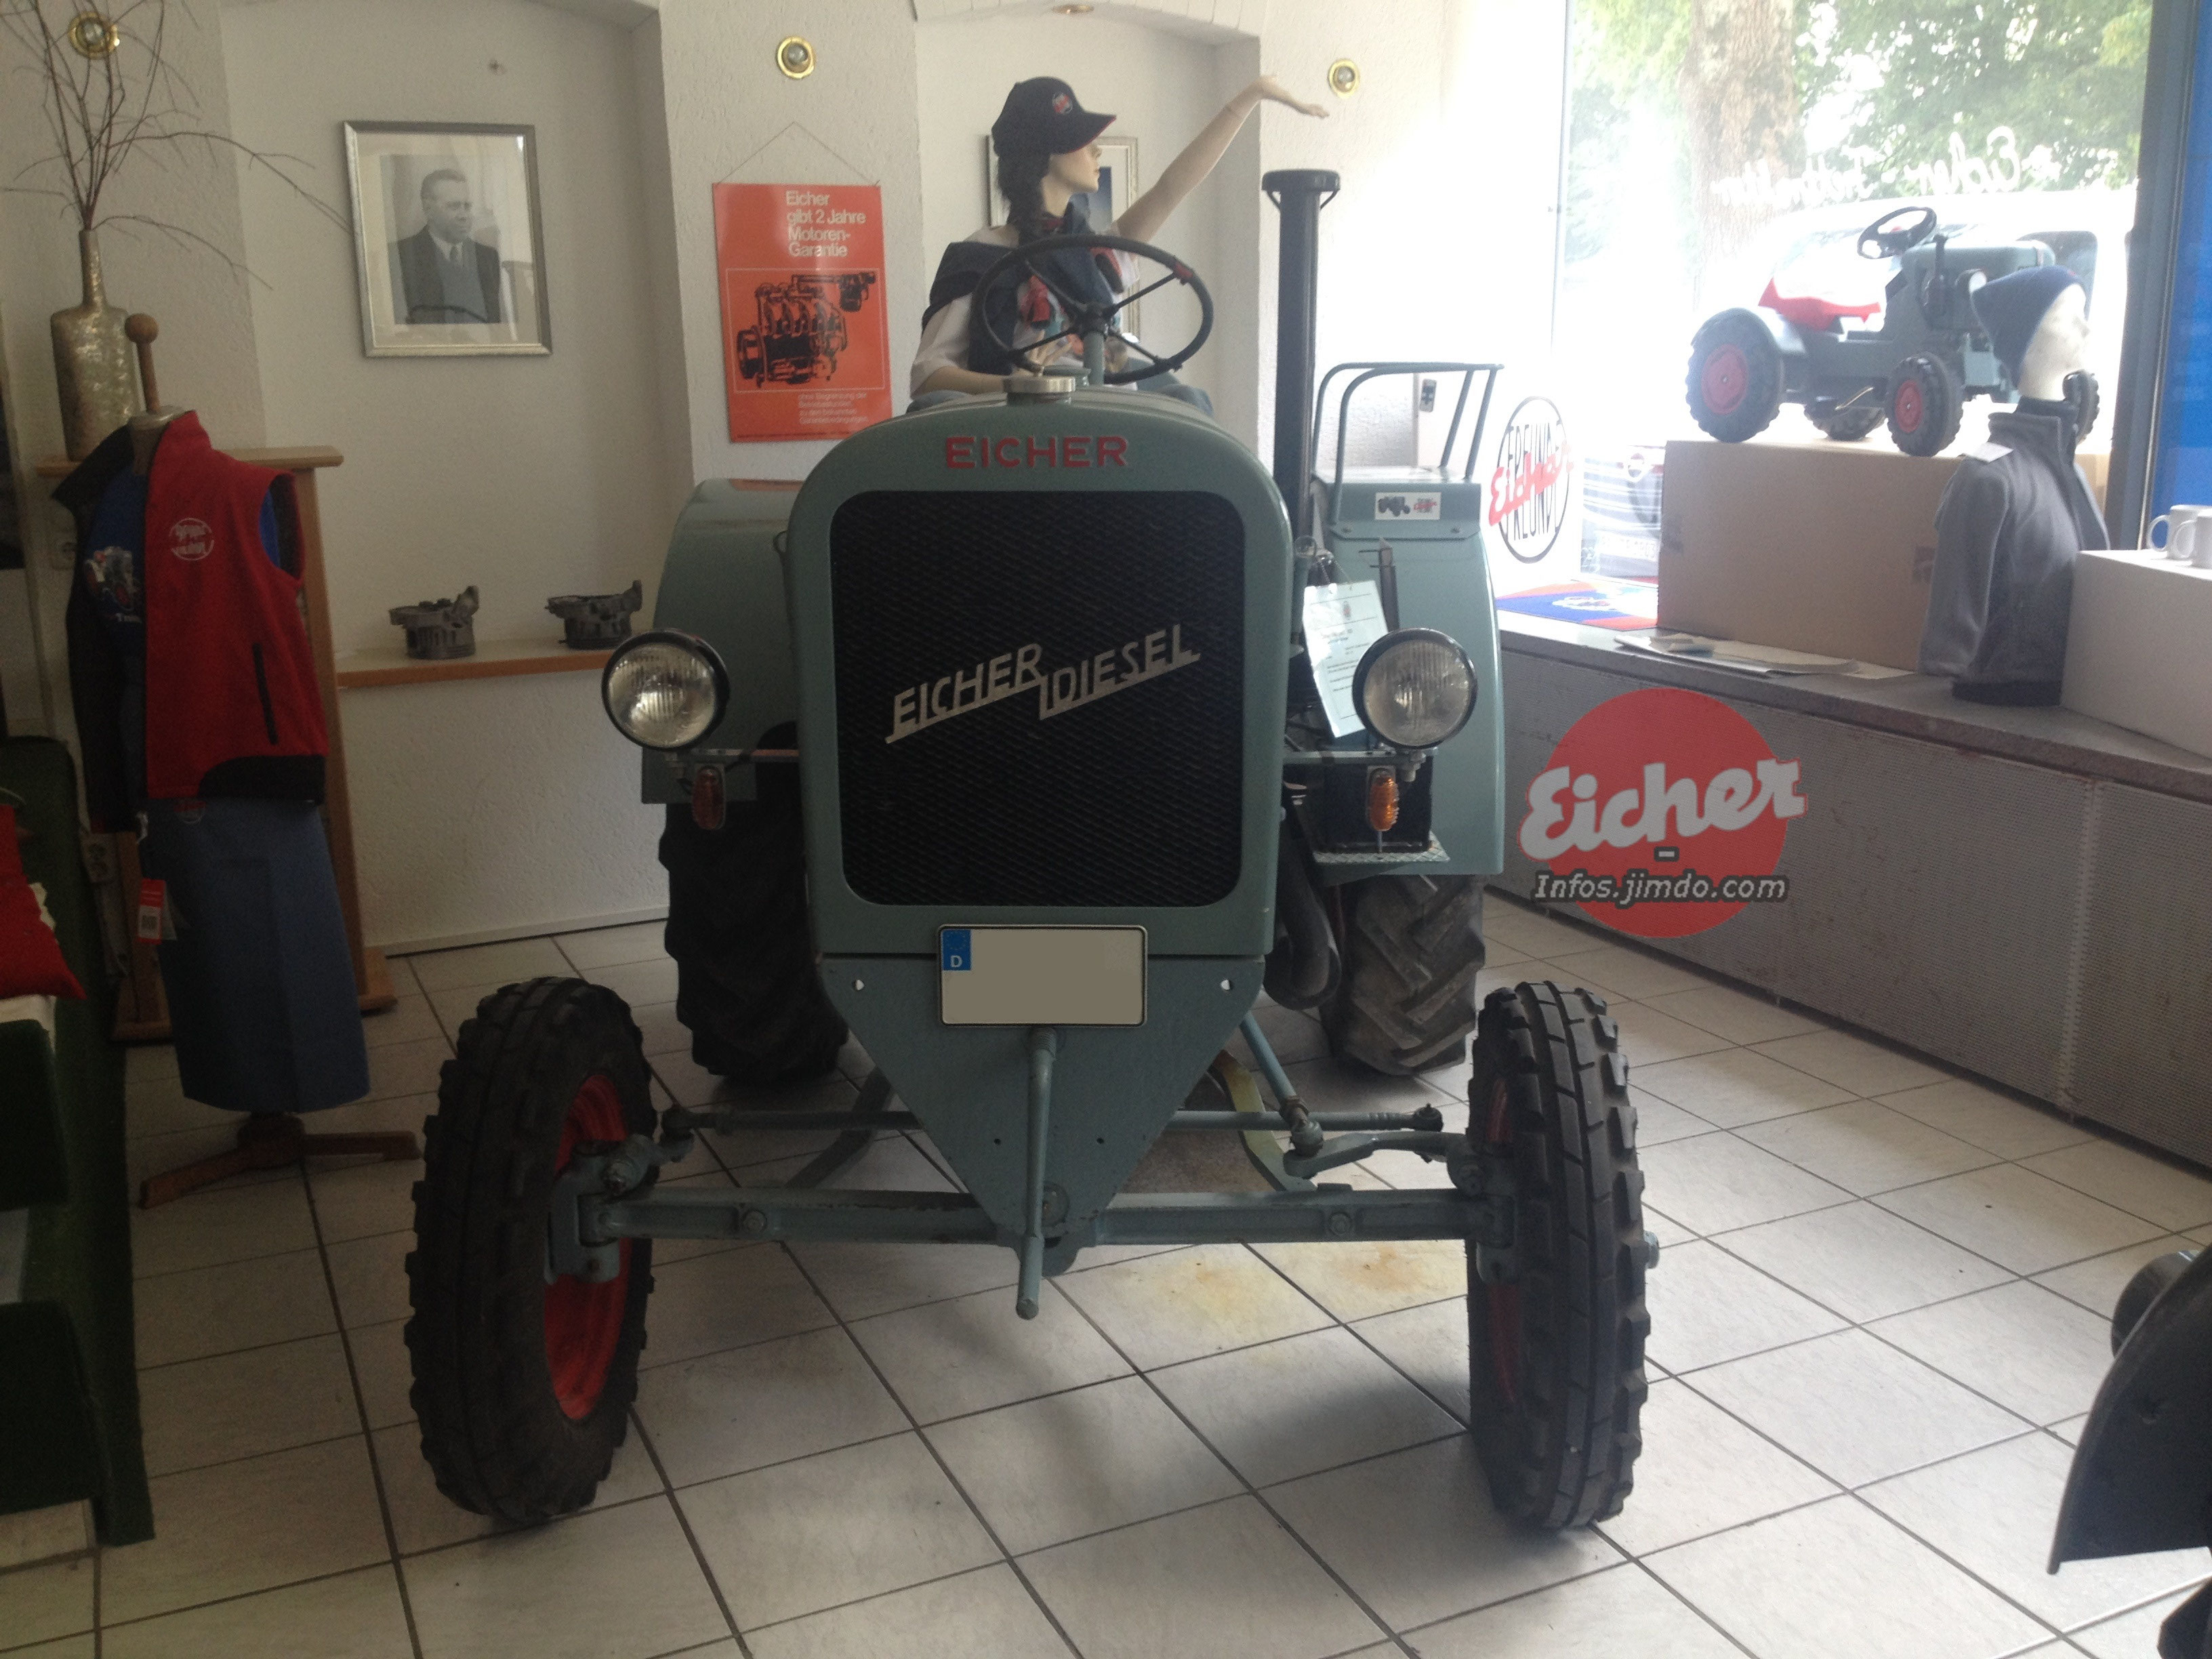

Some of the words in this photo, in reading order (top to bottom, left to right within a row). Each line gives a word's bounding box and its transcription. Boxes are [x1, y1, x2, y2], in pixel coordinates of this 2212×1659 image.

[785, 190, 830, 205] Eicher
[787, 209, 813, 226] gibt
[815, 209, 825, 224] 2
[827, 209, 866, 224] Jahre
[788, 226, 851, 241] Motoren-
[788, 242, 848, 257] Garantie
[945, 436, 1128, 468] EICHER
[885, 643, 1044, 744] EICHER
[1039, 624, 1201, 720] DIESEL
[950, 955, 962, 967] D
